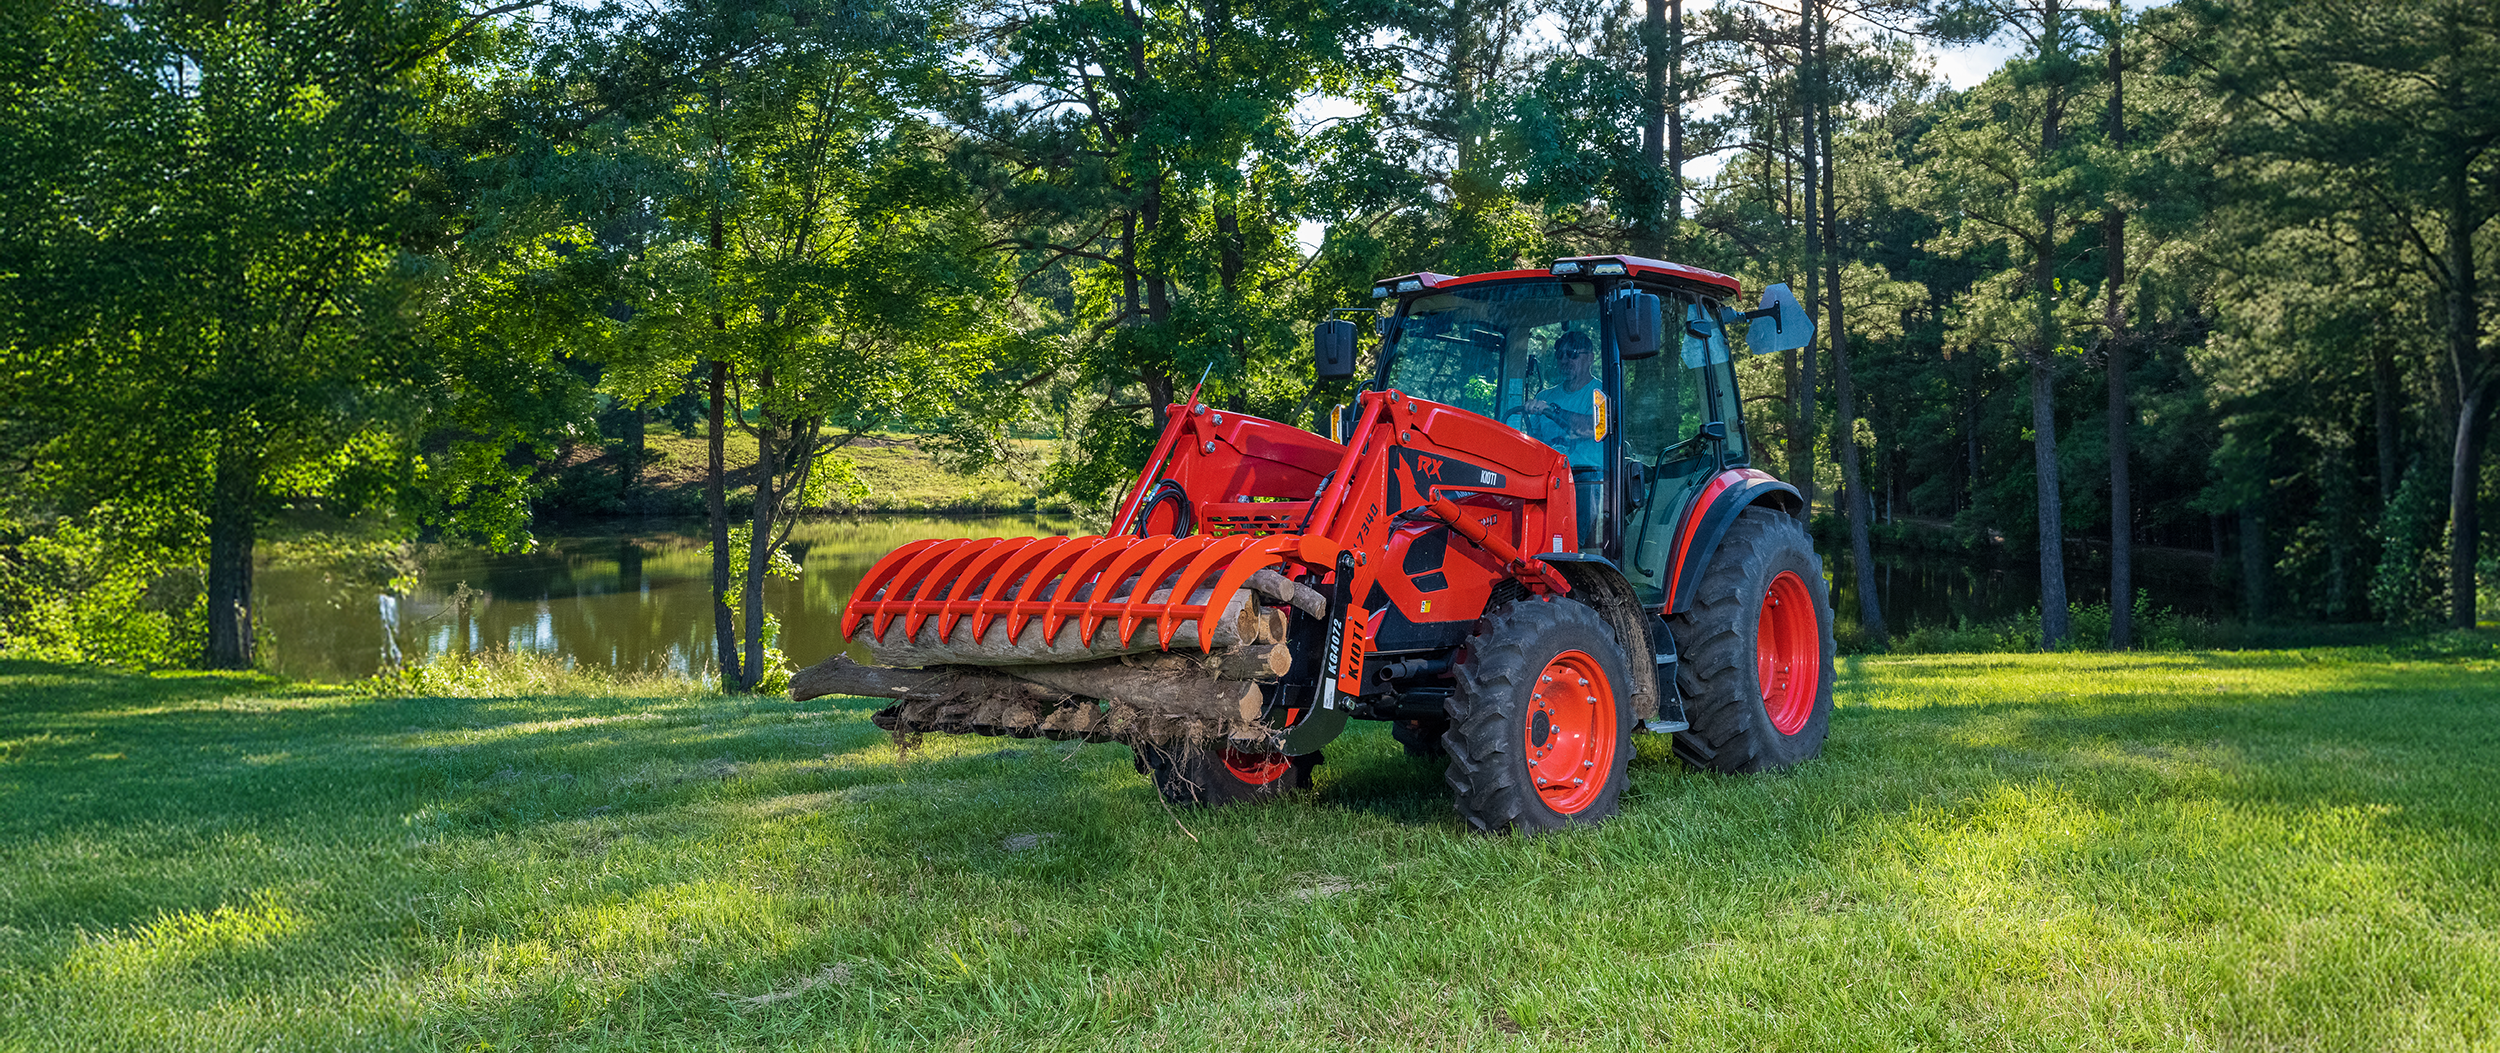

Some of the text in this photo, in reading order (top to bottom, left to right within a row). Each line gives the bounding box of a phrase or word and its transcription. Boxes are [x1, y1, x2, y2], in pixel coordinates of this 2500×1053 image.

[1417, 454, 1443, 482] RX
[1480, 470, 1497, 486] KIOTI
[1327, 618, 1342, 675] KG4072
[1348, 620, 1365, 680] KIOTI
